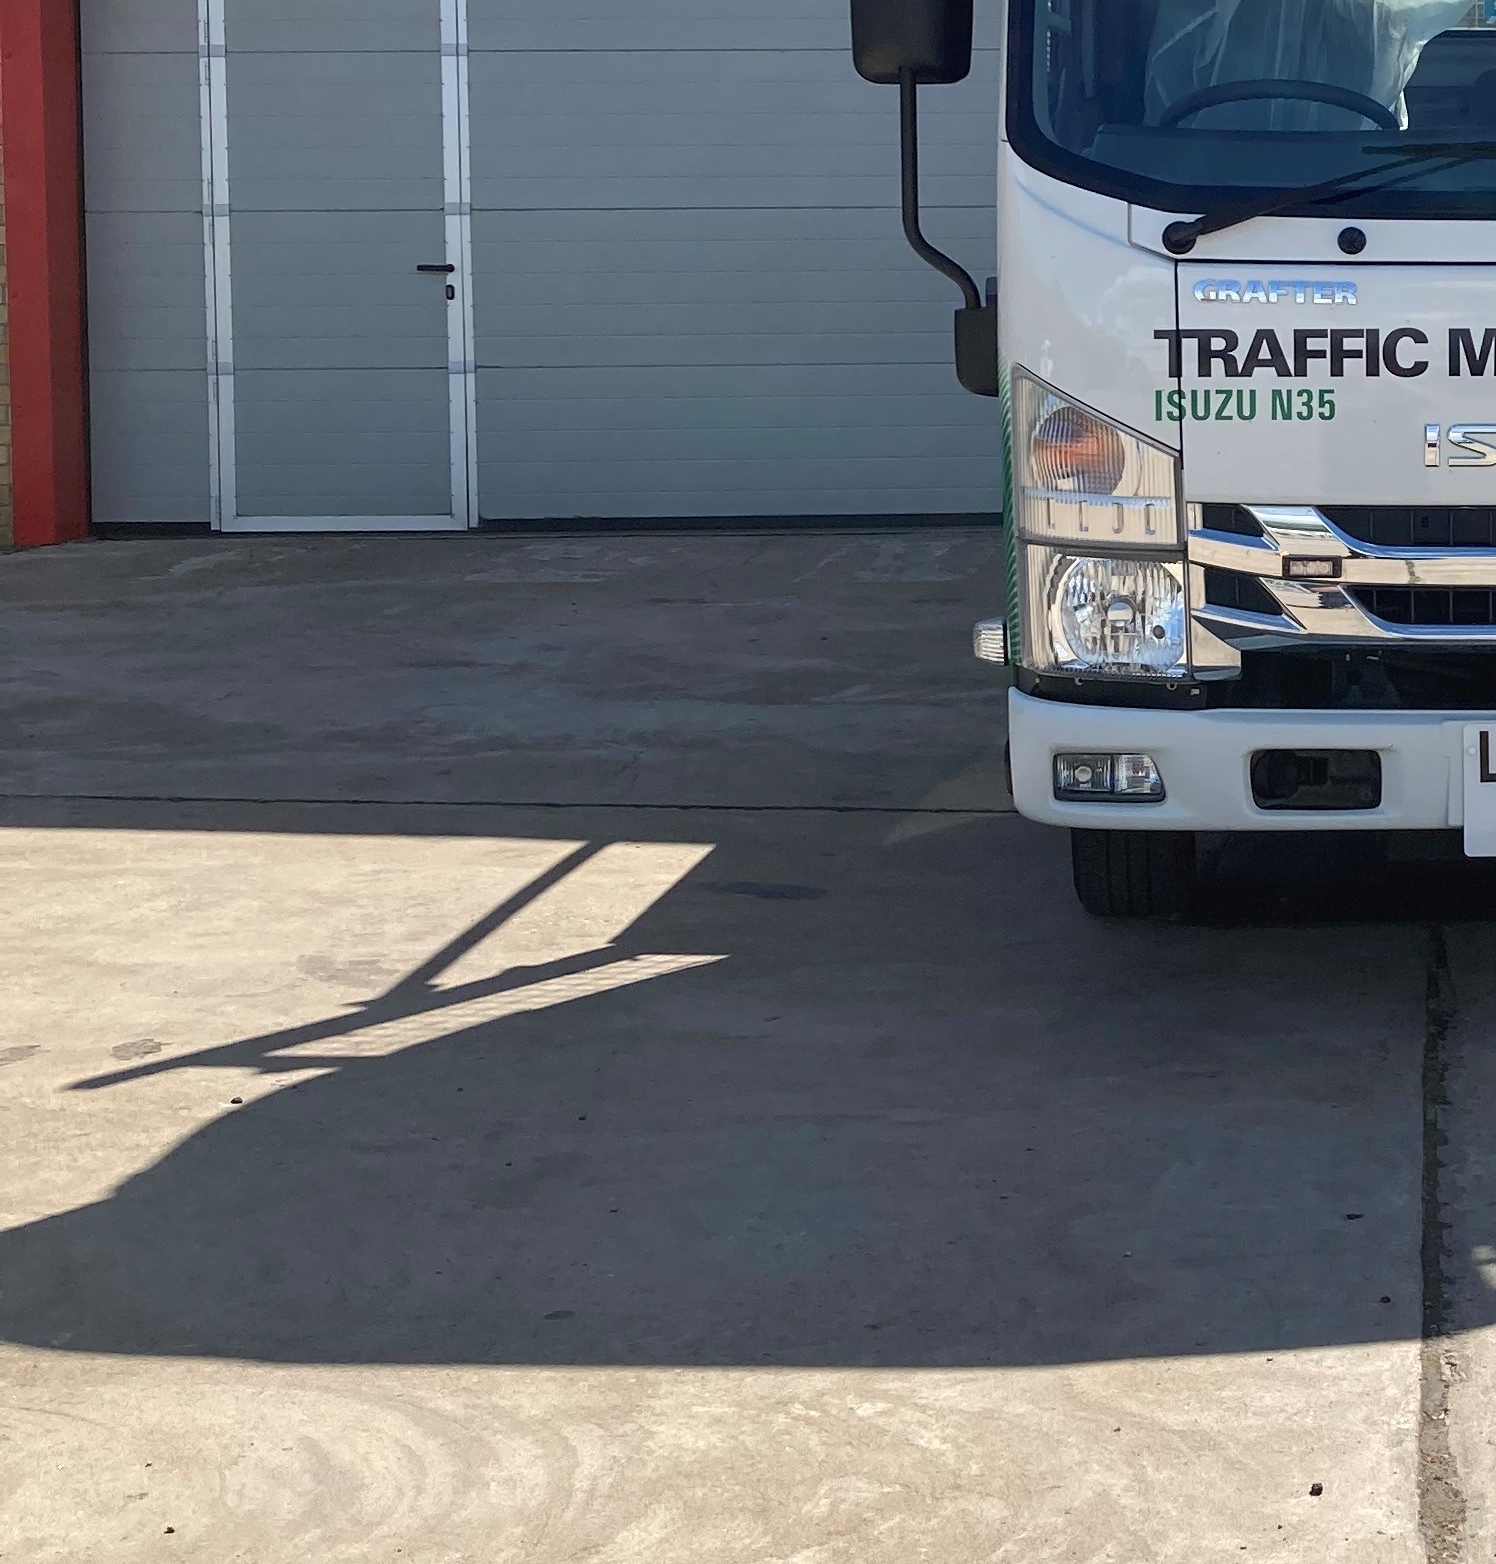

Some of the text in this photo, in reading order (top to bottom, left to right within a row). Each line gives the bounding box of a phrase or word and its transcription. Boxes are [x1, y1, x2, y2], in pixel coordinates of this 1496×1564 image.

[1193, 279, 1357, 304] GRAFTER
[1154, 327, 1429, 378] TRAFFIC
[1155, 389, 1336, 421] ISUZU N35
